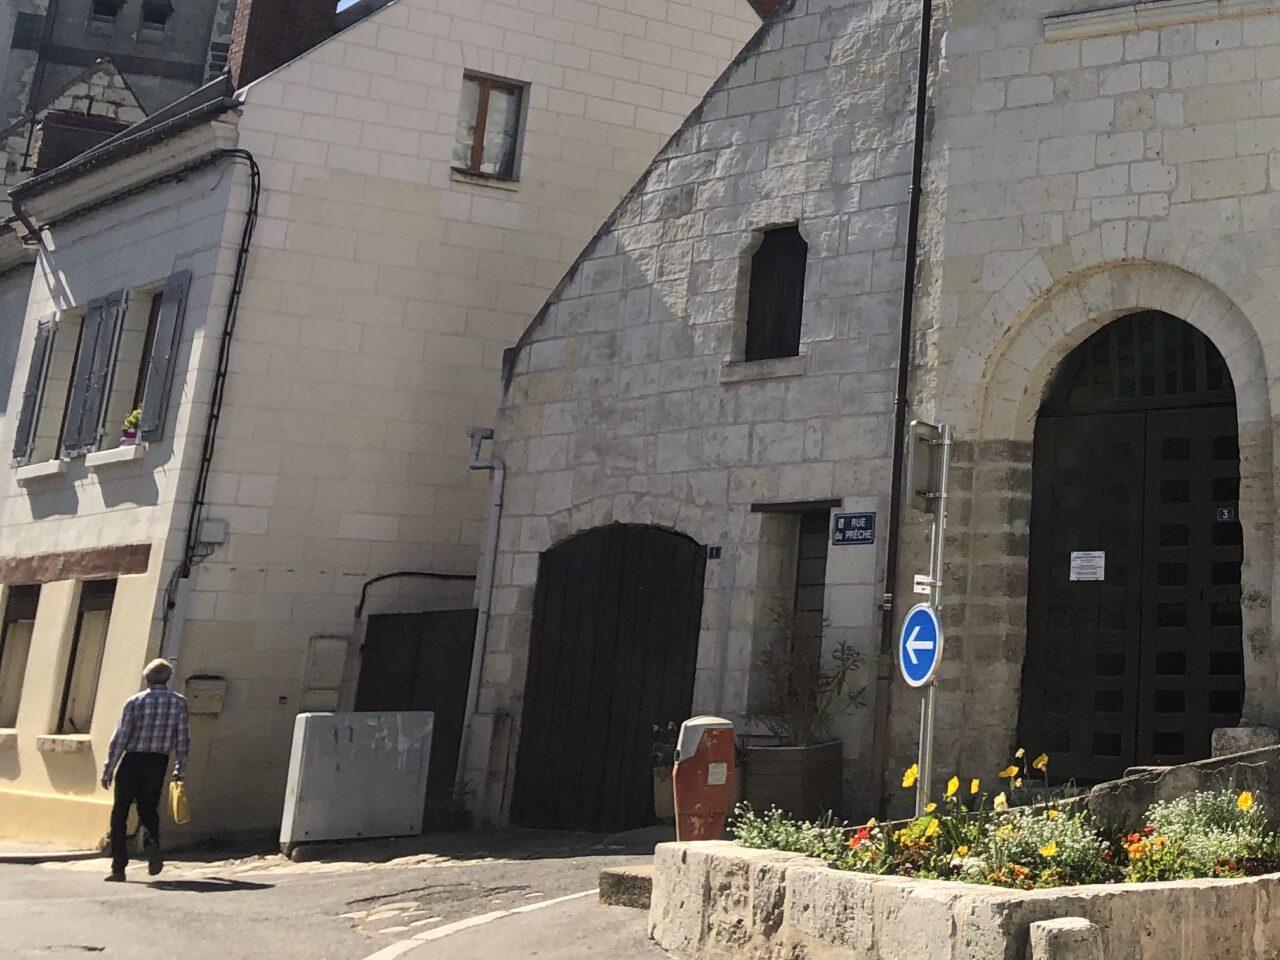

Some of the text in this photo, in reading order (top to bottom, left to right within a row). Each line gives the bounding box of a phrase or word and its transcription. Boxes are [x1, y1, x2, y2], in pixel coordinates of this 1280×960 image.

[1222, 509, 1229, 519] 3
[851, 518, 866, 528] RUE
[834, 531, 843, 540] du
